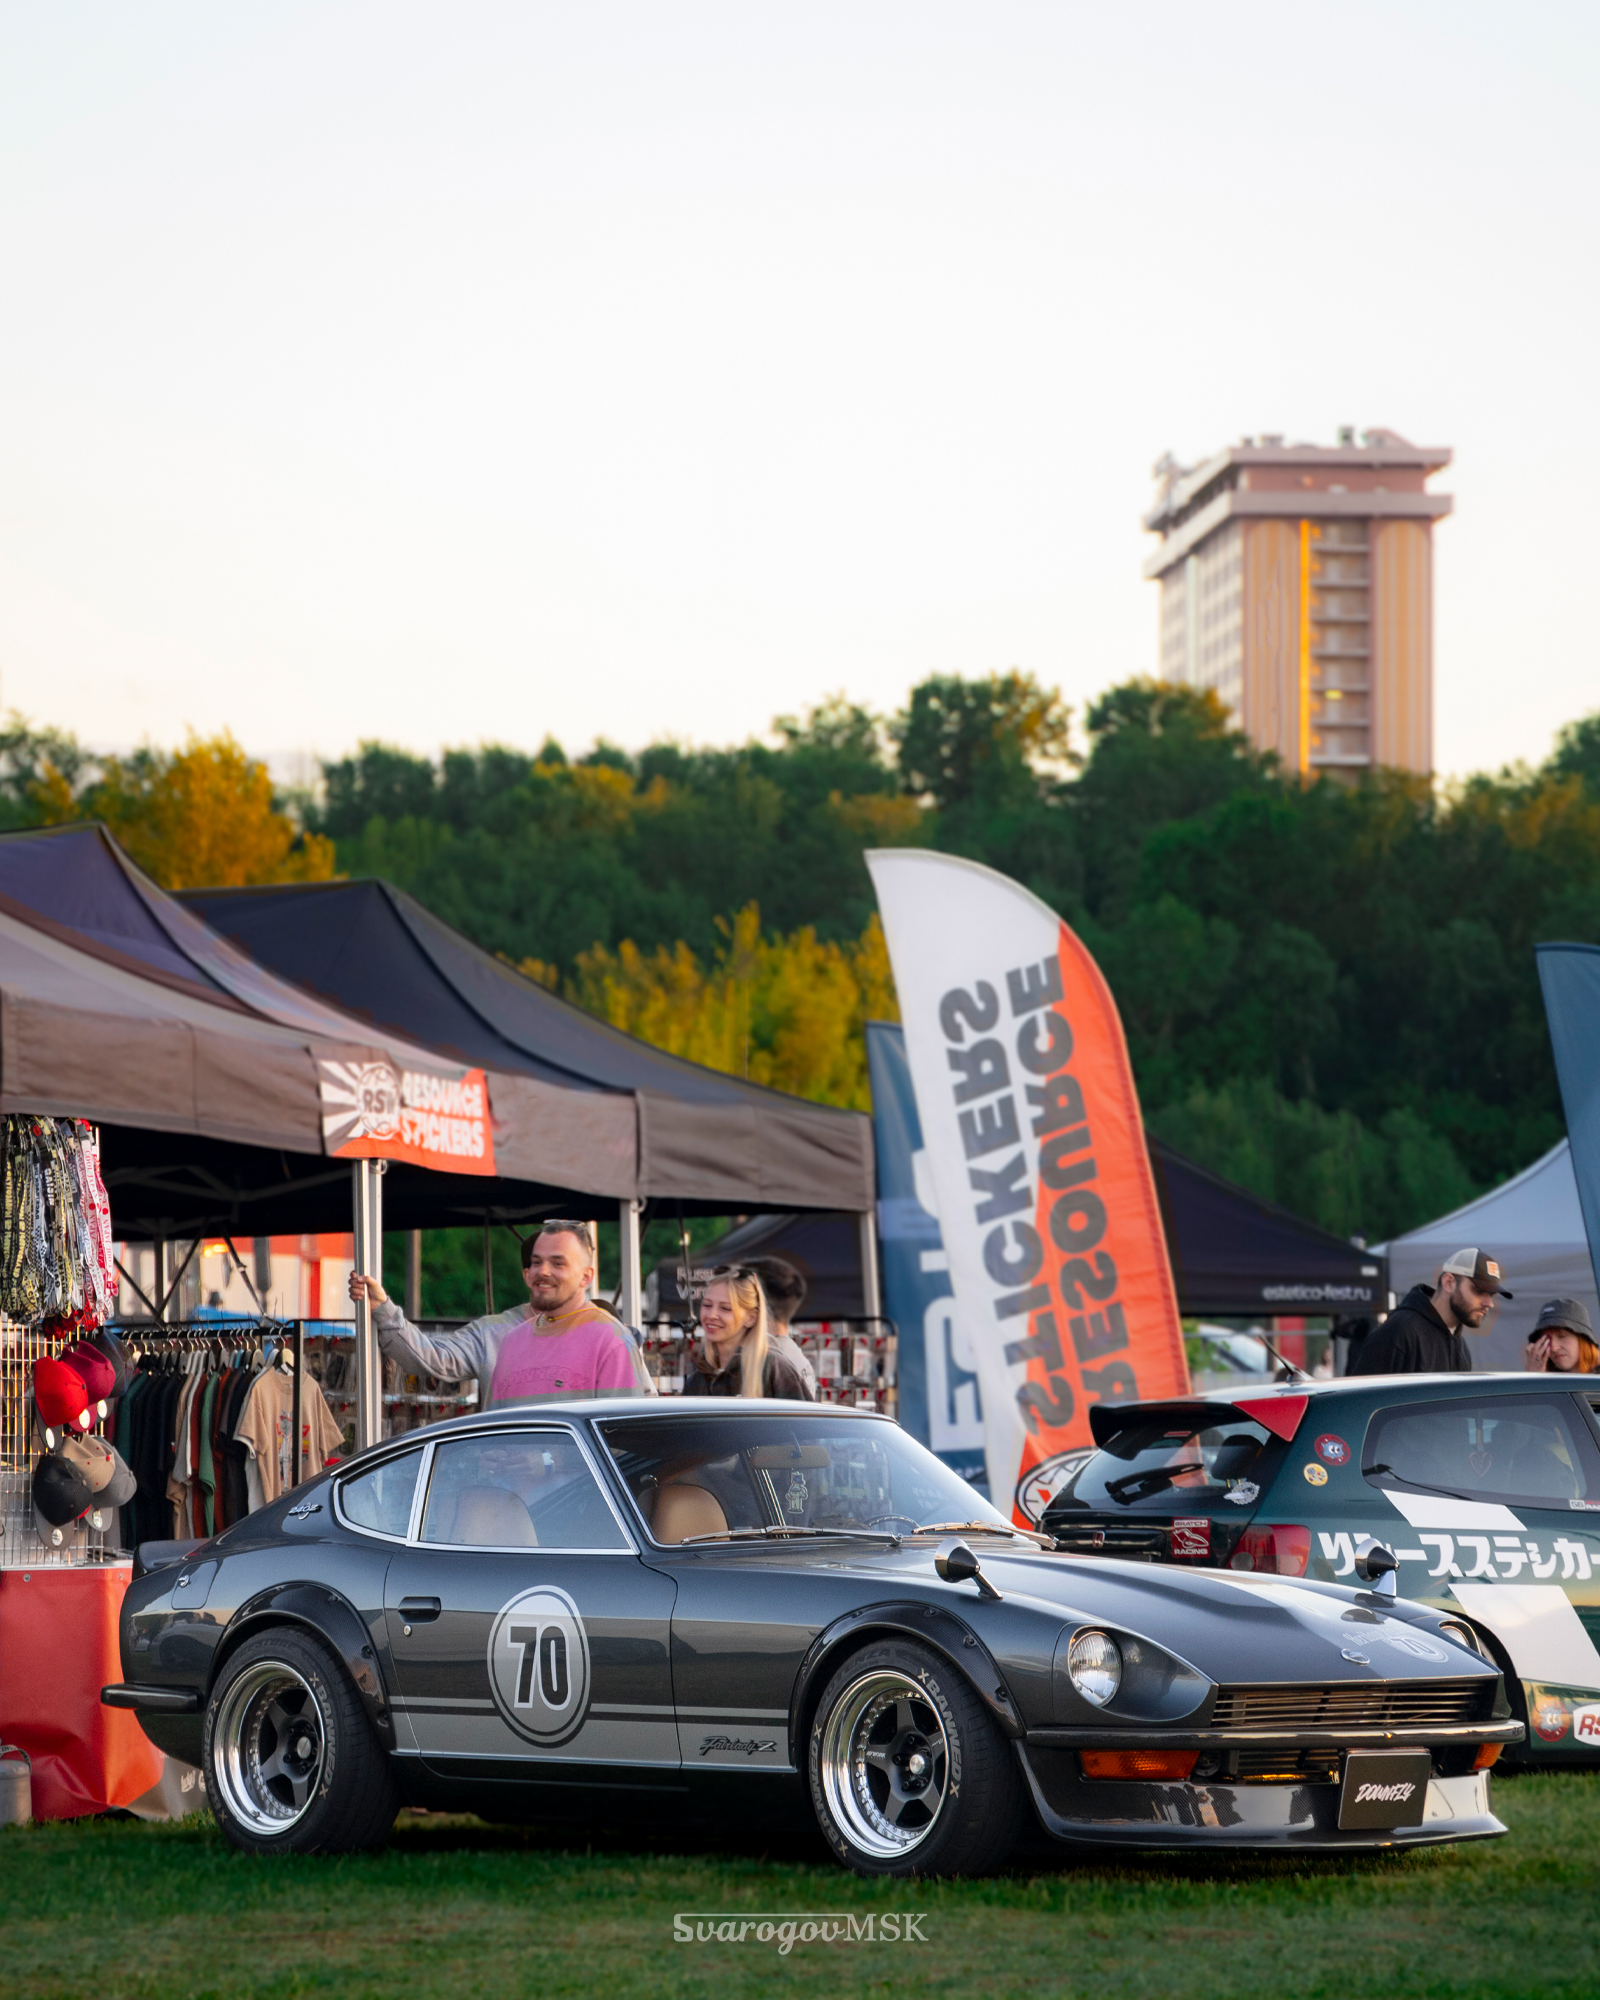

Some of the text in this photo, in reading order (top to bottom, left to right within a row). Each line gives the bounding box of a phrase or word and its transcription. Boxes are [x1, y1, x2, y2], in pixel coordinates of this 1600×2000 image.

[1263, 1284, 1372, 1300] estetico-fest.ru
[1388, 1635, 1440, 1656] 70
[506, 1621, 572, 1711] 70
